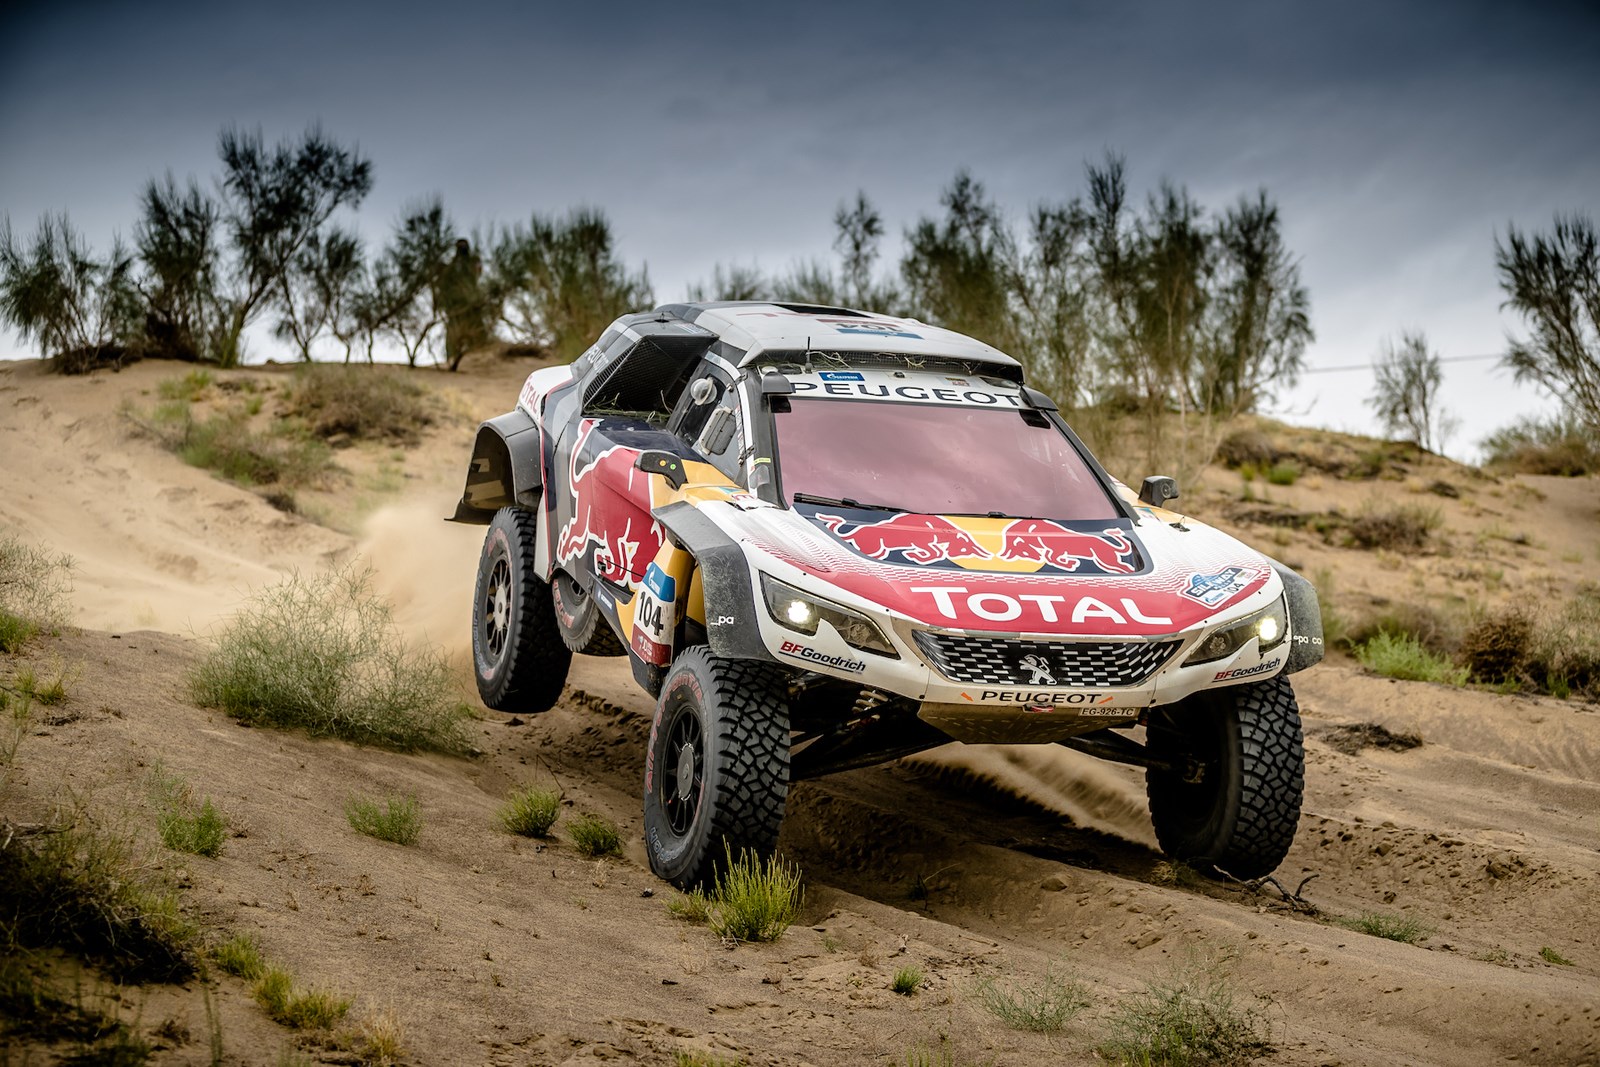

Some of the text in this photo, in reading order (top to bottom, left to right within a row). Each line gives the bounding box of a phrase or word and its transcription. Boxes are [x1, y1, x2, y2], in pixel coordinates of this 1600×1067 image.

[789, 382, 1020, 407] PEUGEOT
[638, 591, 664, 636] 104
[909, 586, 1173, 625] TOTAL
[780, 640, 867, 672] BFGoodrich
[1214, 657, 1281, 680] BFGoodrich
[980, 690, 1102, 704] PEUGEOT
